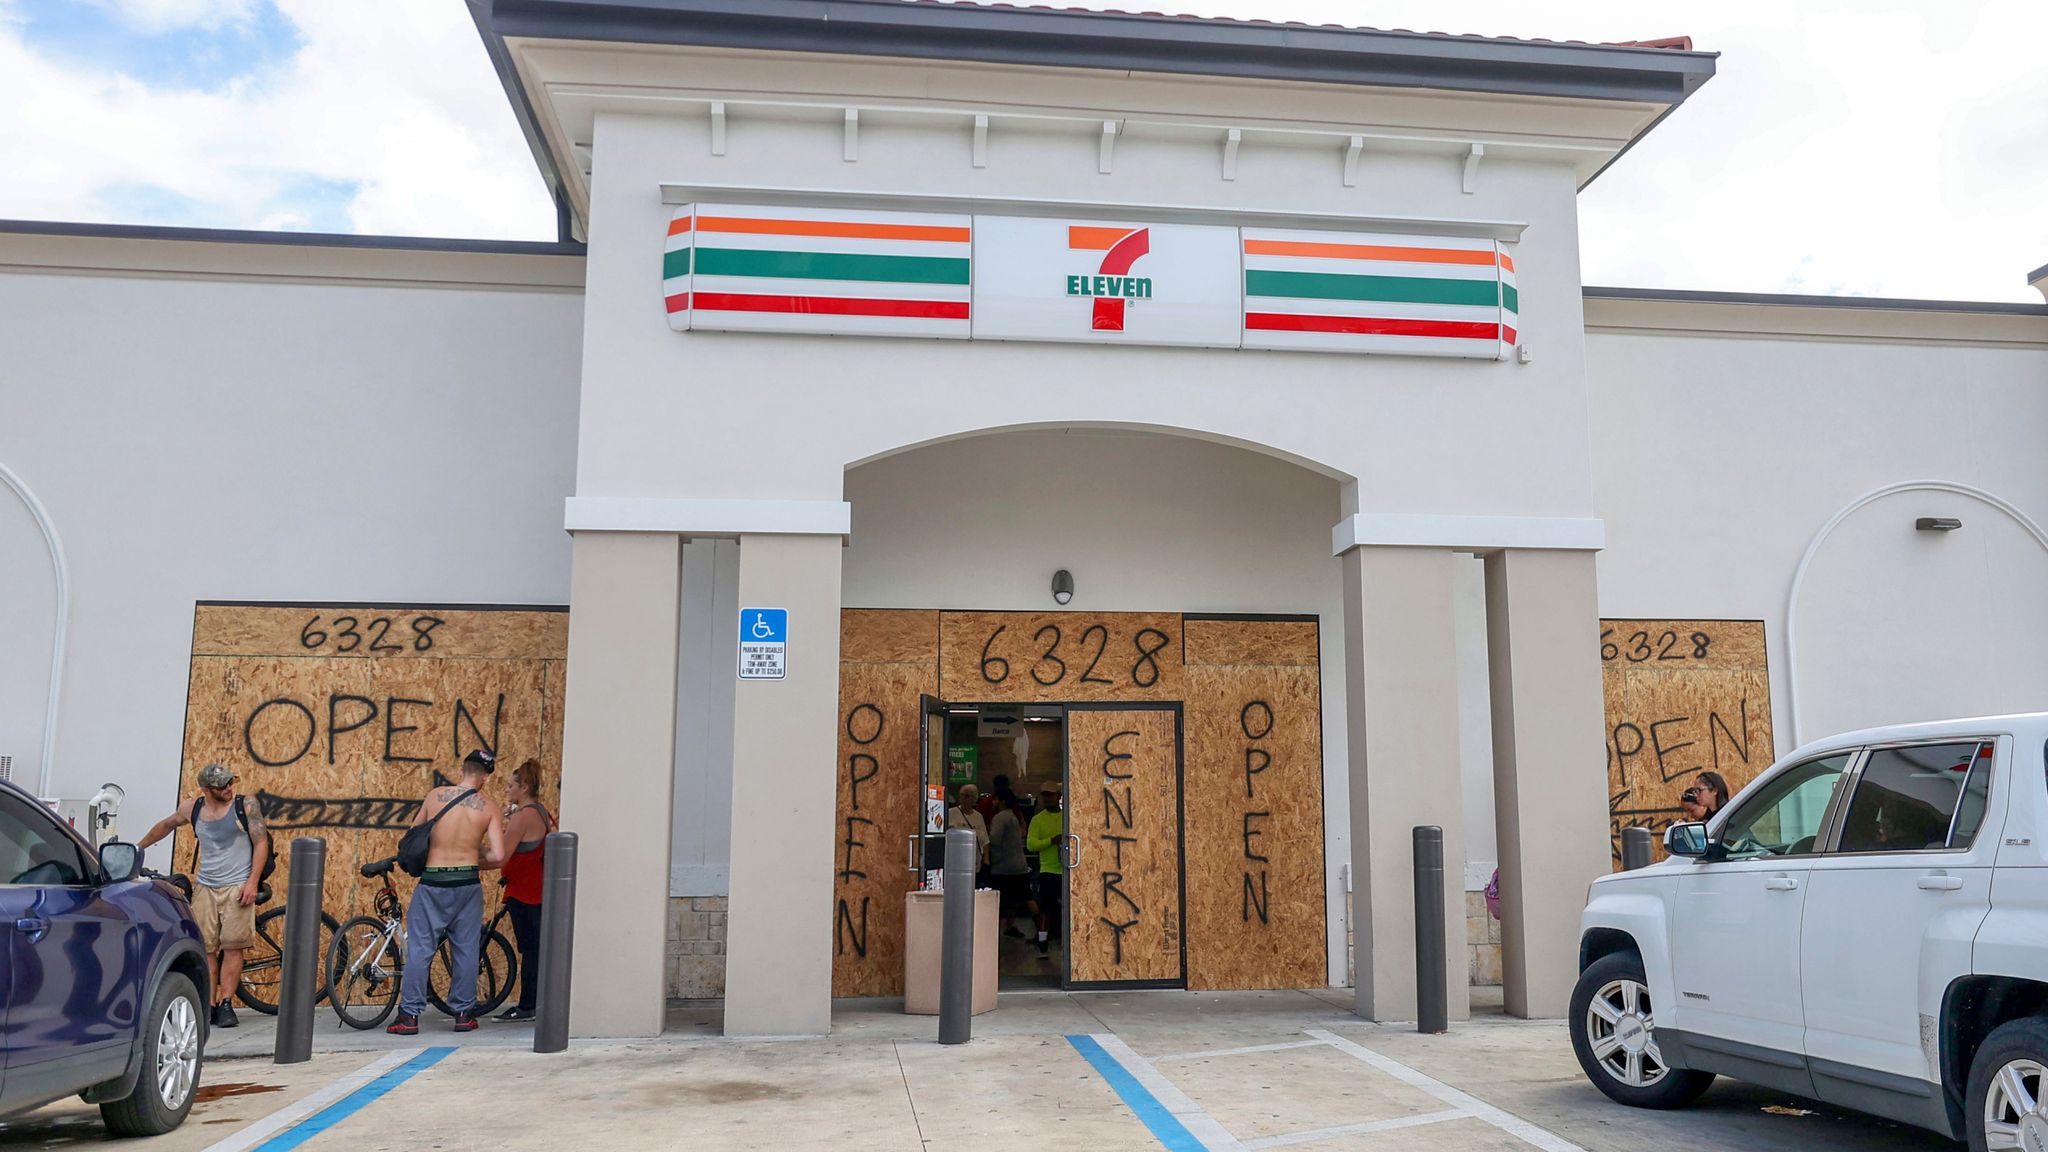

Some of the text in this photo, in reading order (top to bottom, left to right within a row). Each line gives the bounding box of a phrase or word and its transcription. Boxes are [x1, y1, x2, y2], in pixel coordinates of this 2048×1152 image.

[1068, 225, 1150, 331] 7
[301, 615, 446, 653] 6328
[980, 624, 1170, 688] 6328
[1600, 629, 1711, 662] 6328
[244, 693, 505, 767] OPEN
[1605, 698, 1748, 788] PEN
[838, 703, 884, 957] OPEN
[1101, 731, 1141, 965] ENTRY
[1240, 700, 1273, 926] OPEN
